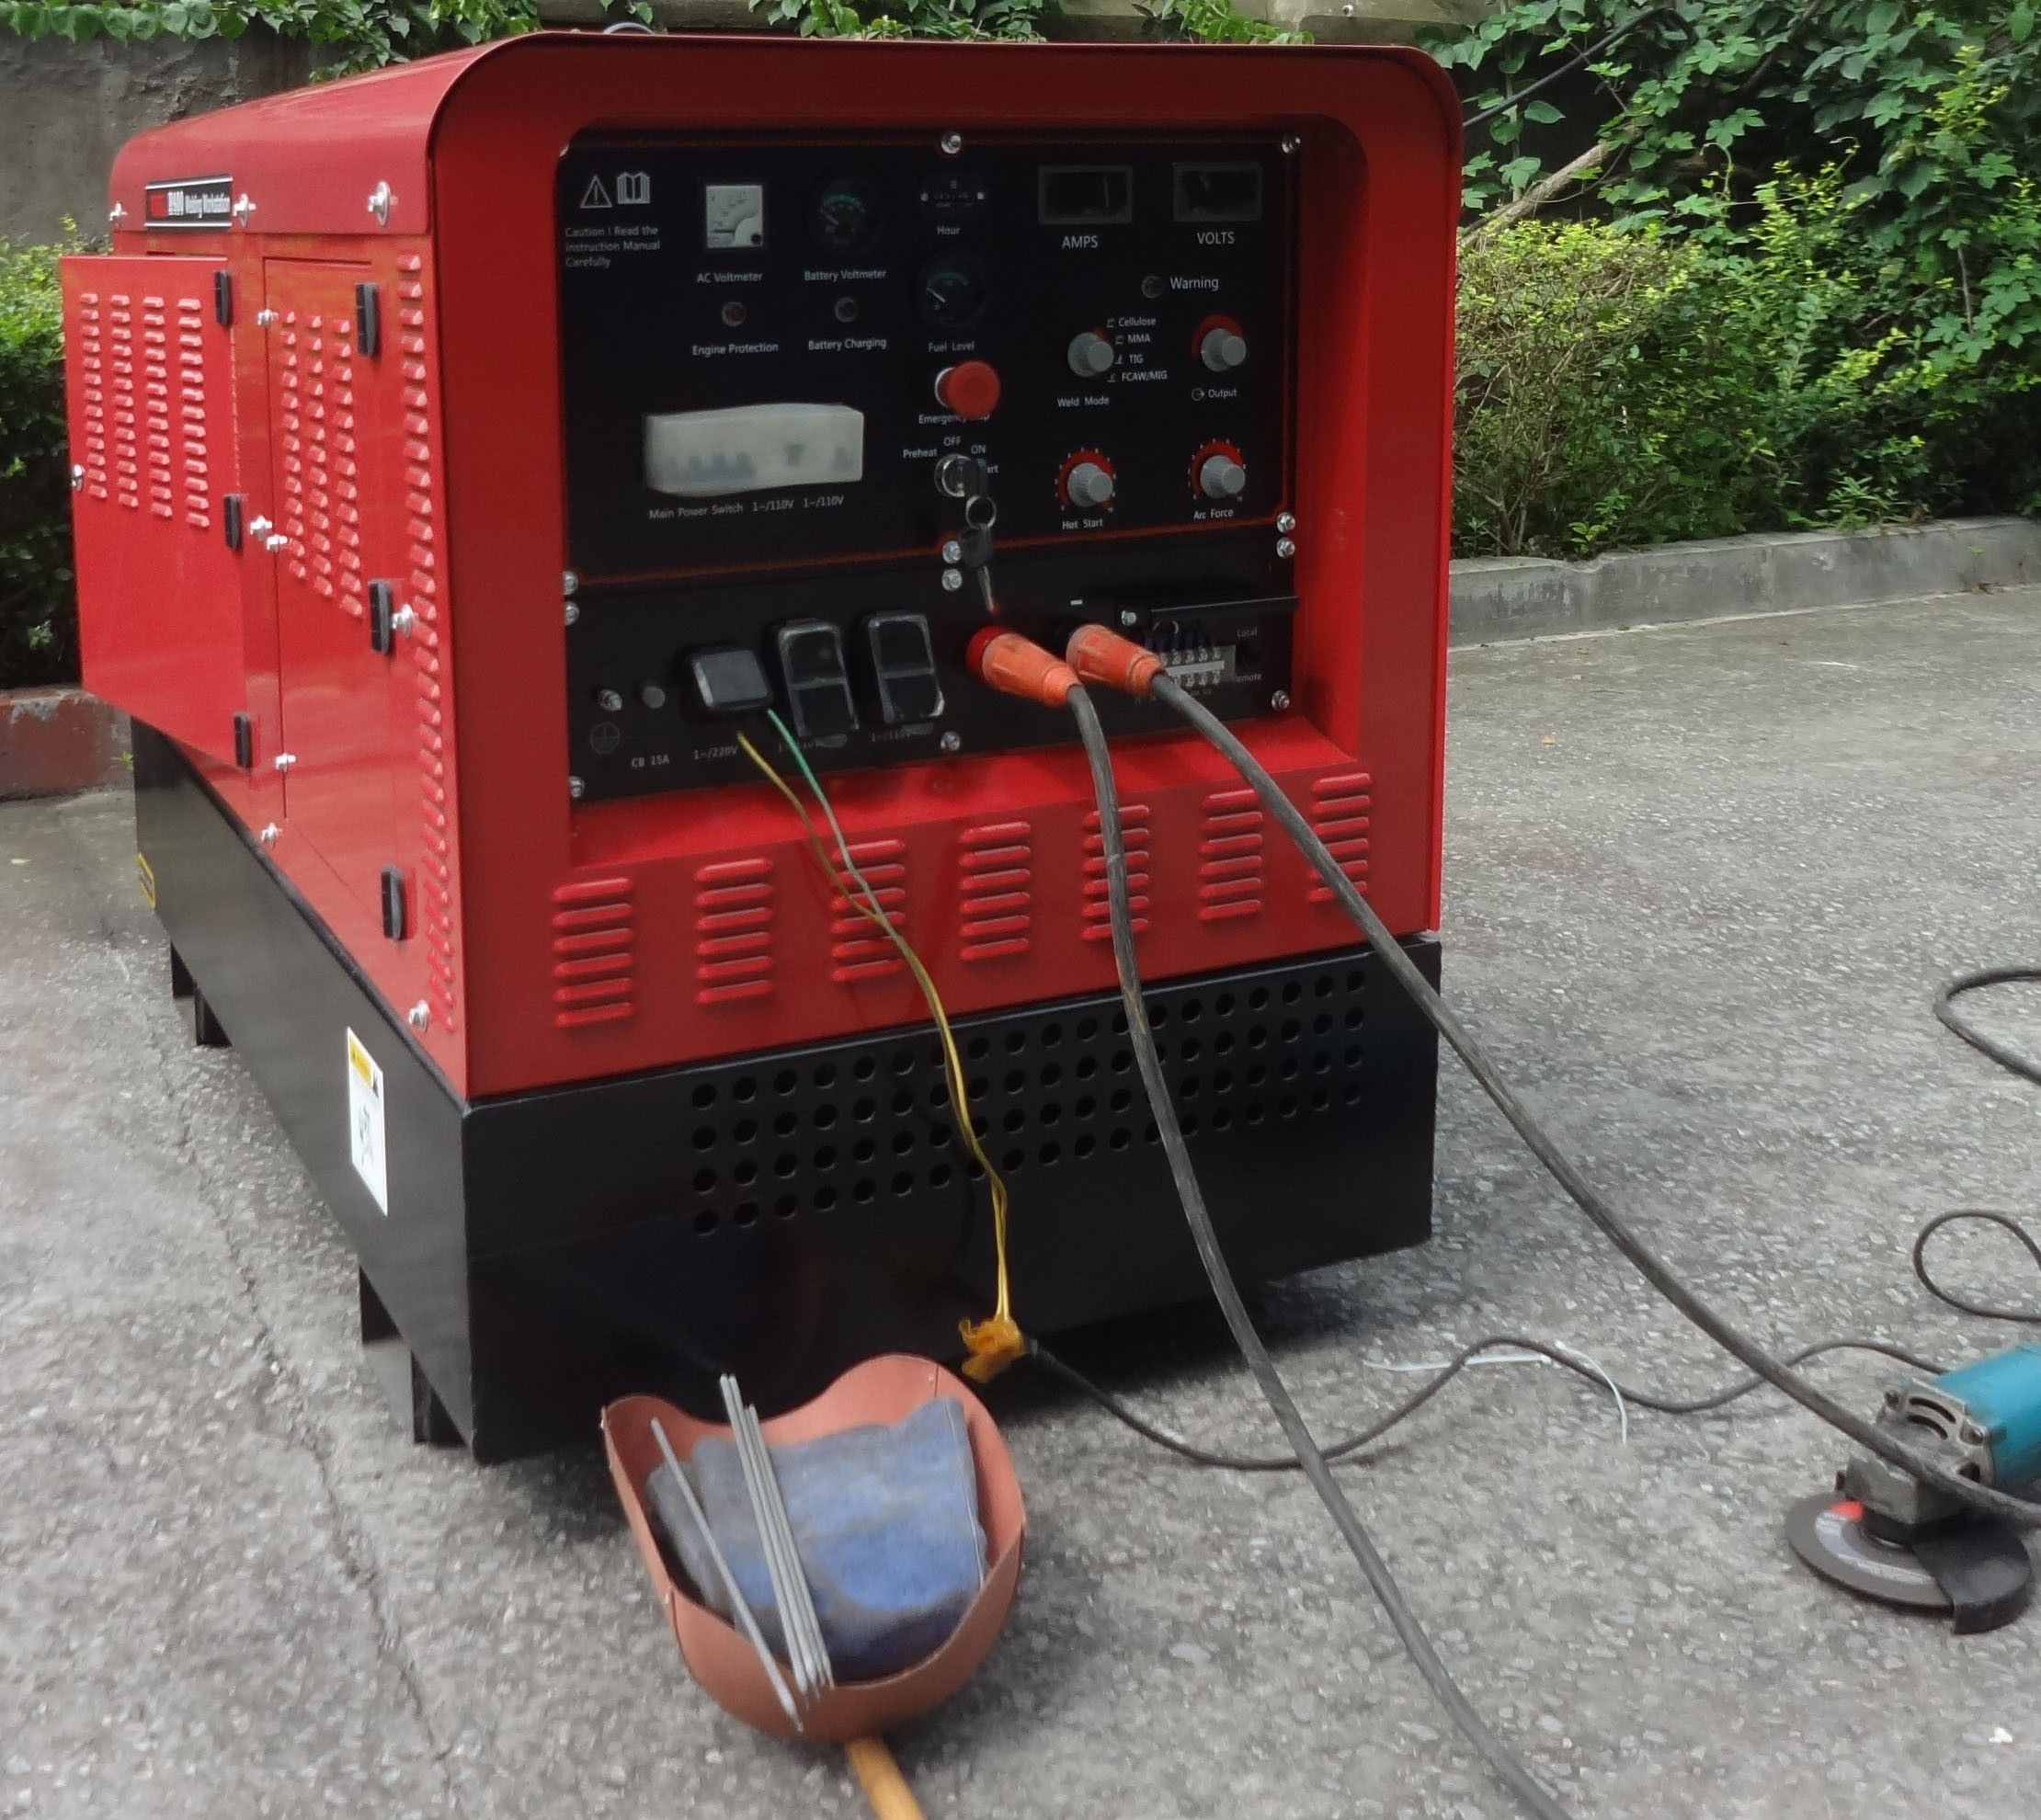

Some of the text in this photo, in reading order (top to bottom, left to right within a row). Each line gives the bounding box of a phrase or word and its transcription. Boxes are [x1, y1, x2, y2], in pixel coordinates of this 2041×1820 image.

[565, 228, 605, 237] Caution
[614, 226, 639, 235] Read
[642, 226, 658, 235] the
[937, 225, 960, 234] Hour
[1063, 235, 1098, 248] AMPS
[1197, 232, 1234, 245] VOLTS
[623, 240, 660, 250] Manual
[566, 256, 610, 268] Carefully
[697, 273, 762, 282] AC Voltmeter
[804, 269, 886, 282] Battery Voltmeter
[1170, 278, 1218, 291] Warning
[1119, 317, 1156, 326] Cellulose
[1128, 334, 1150, 343] MMA
[808, 338, 886, 351] Battery Charging
[929, 341, 975, 352] Fuel Level
[692, 343, 778, 358] Engine Protection
[1129, 354, 1143, 363] TIG
[1122, 370, 1167, 381] FCAW/MIG
[1208, 389, 1237, 399] Output
[1057, 395, 1109, 406] Weld Mode
[943, 437, 961, 446] OFF
[903, 449, 937, 458] Preheat
[971, 445, 986, 454] ON
[649, 503, 743, 518] Main Power Switch
[1193, 508, 1233, 519] Arc Force
[1063, 518, 1102, 529] Hot Start
[1237, 627, 1257, 638] Local
[651, 755, 669, 765] 15A
